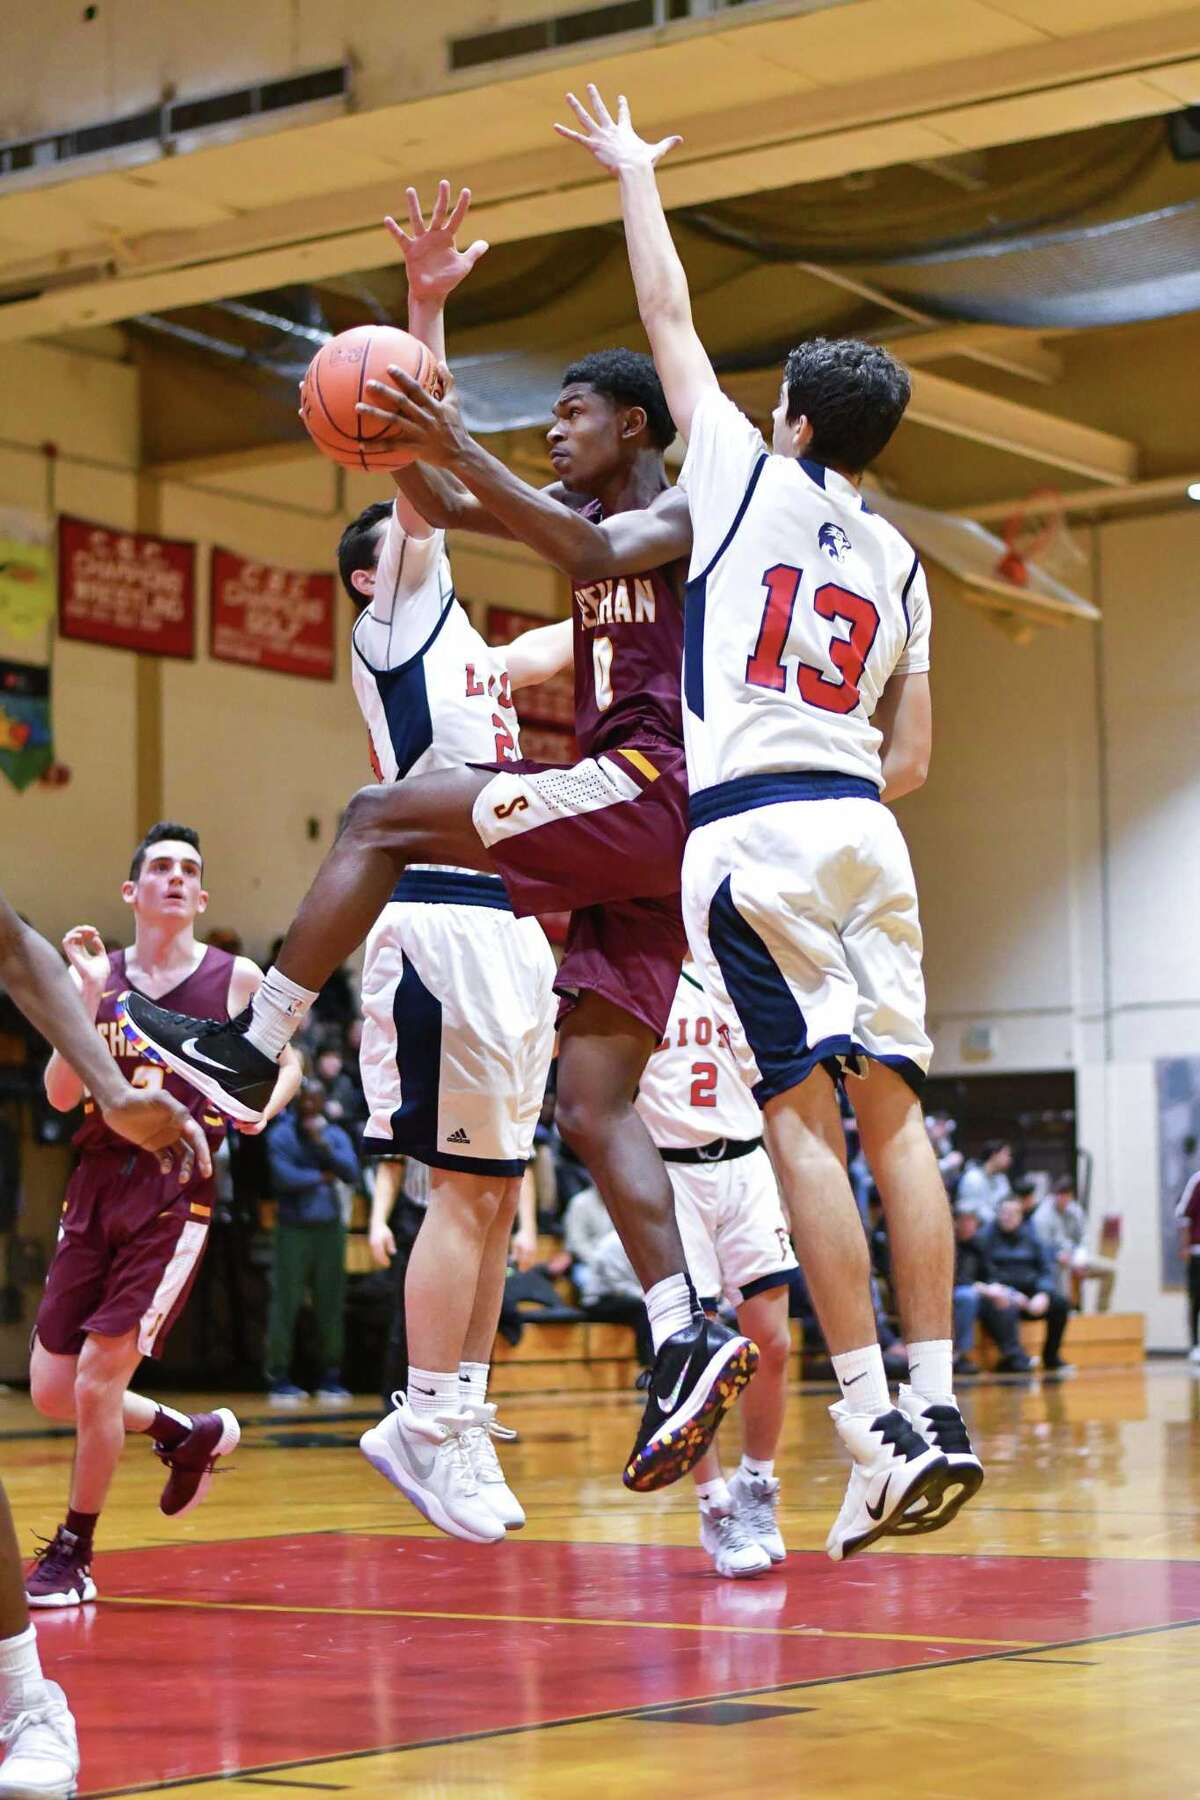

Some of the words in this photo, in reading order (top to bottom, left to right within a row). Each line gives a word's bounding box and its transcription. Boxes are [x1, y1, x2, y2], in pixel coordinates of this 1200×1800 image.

[592, 636, 614, 712] 0
[745, 563, 880, 714] 13
[690, 1062, 717, 1107] 2
